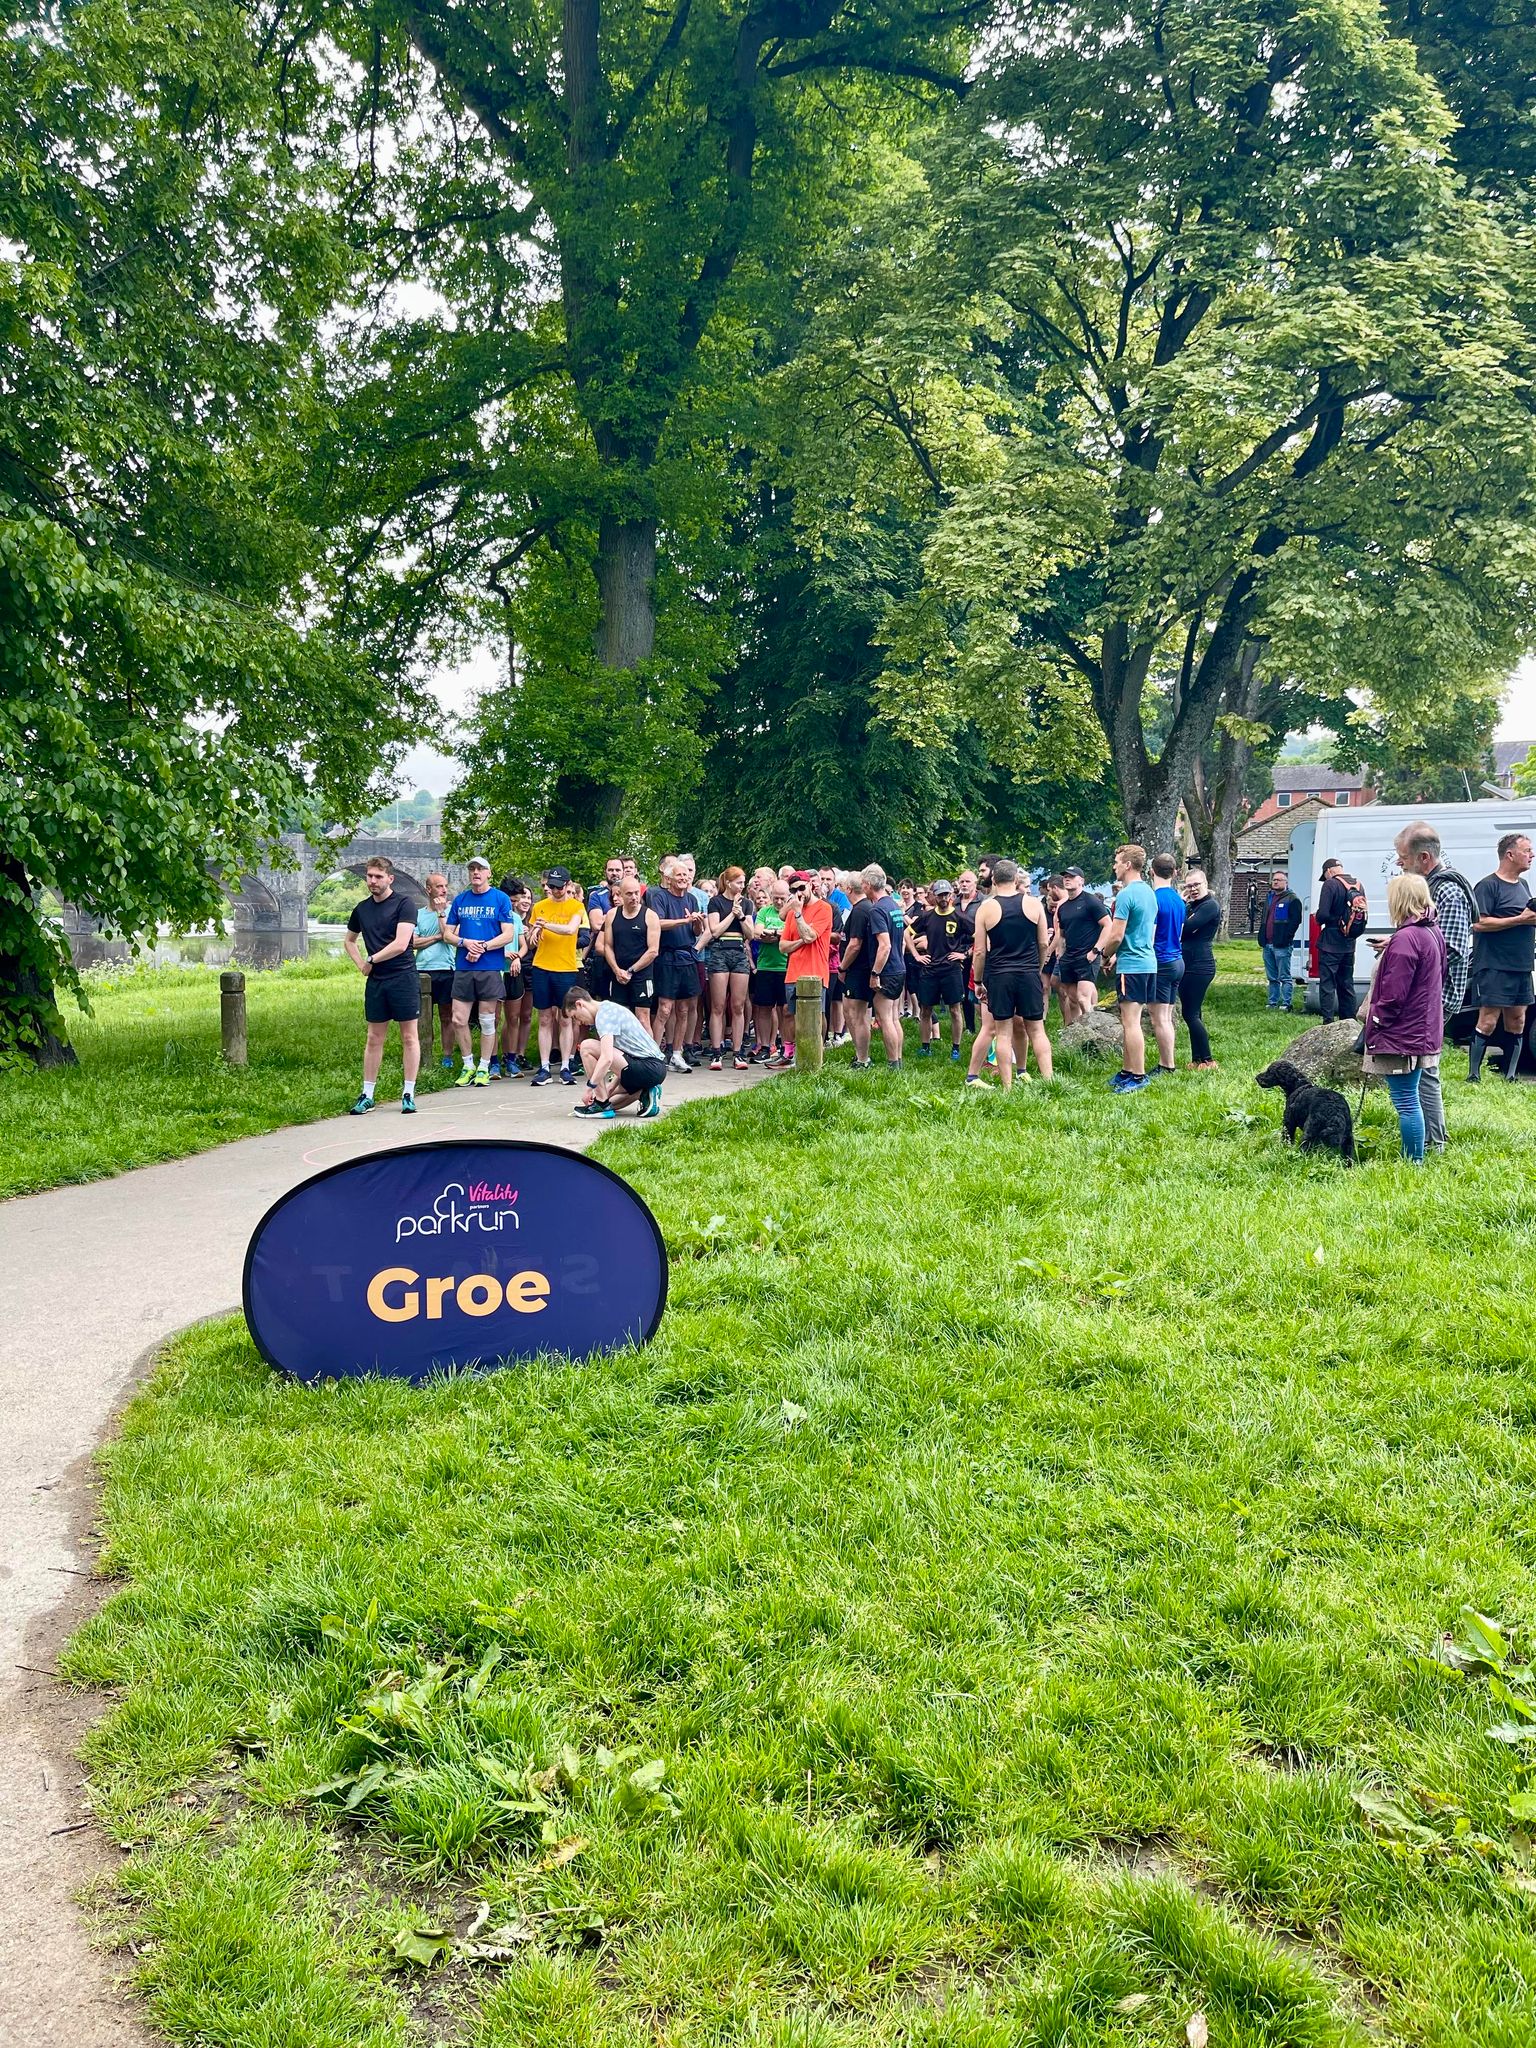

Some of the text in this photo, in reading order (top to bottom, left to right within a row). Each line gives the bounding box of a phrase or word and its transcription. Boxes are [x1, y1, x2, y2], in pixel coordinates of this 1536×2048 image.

[457, 906, 496, 916] CARDIFF 5K
[469, 1181, 519, 1206] Vitality
[396, 1187, 520, 1243] parkrun
[366, 1267, 551, 1323] Groe
